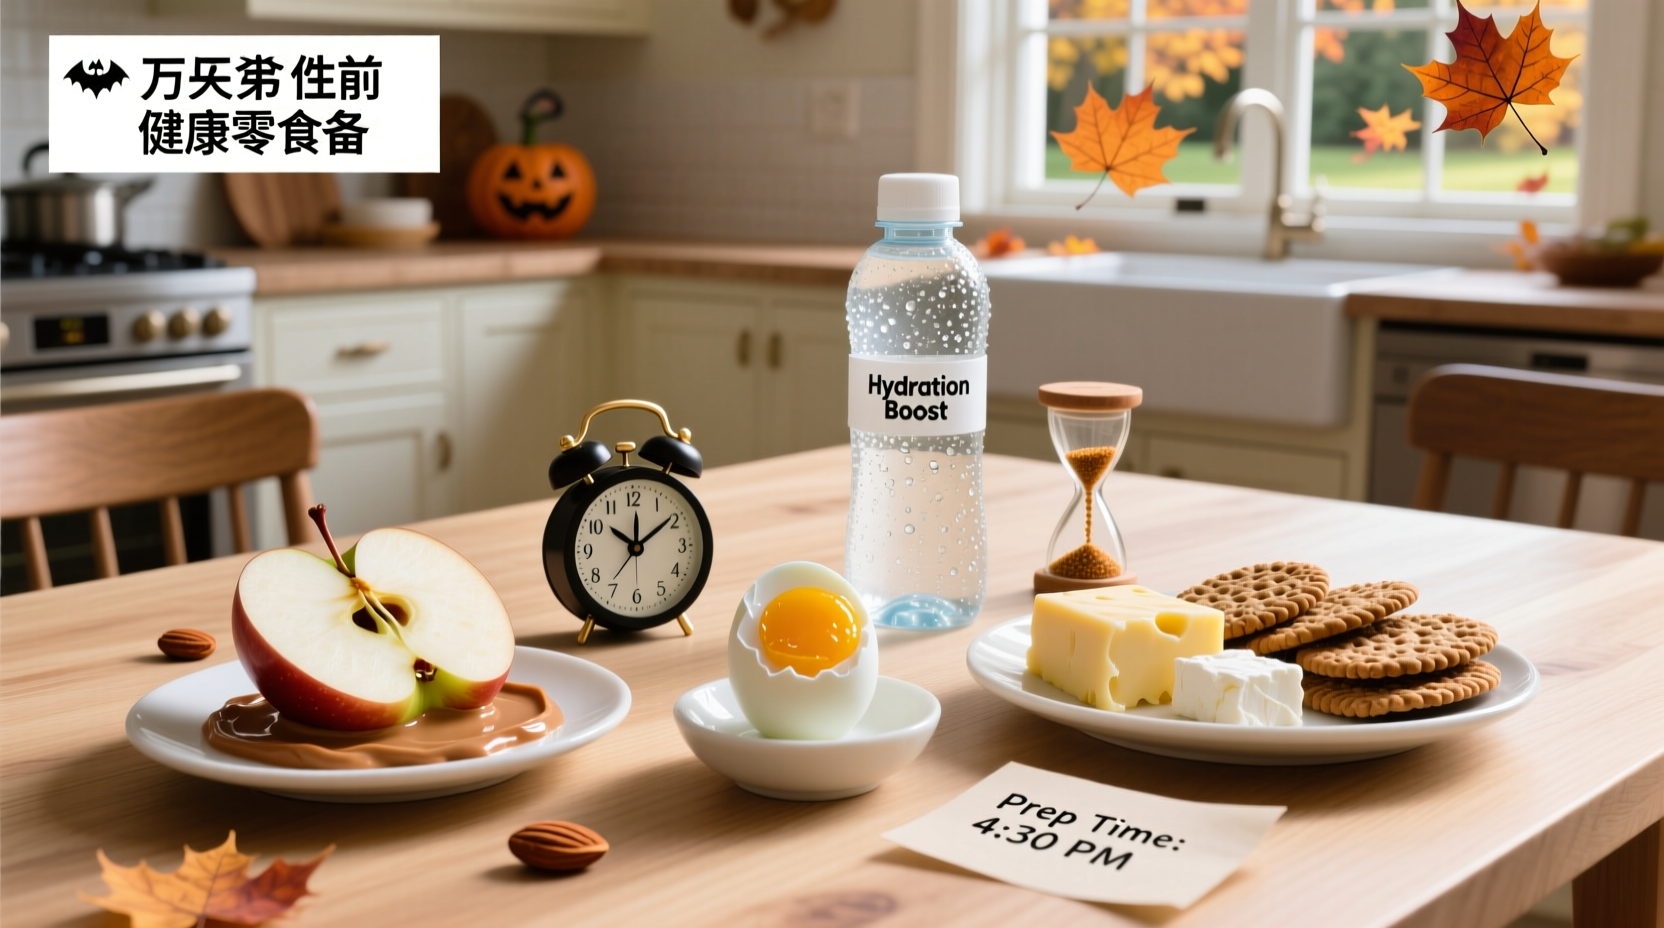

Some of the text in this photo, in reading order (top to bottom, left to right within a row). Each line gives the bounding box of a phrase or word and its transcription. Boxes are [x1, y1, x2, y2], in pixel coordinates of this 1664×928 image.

[868, 373, 970, 400] Hydration
[884, 400, 949, 421] Boost
[606, 500, 616, 515] 11
[626, 491, 641, 508] 12
[589, 519, 604, 535] 10
[669, 513, 680, 530] 2
[583, 543, 593, 560] 9
[677, 537, 687, 554] 3
[591, 567, 601, 584] 8
[670, 562, 680, 578] 4
[607, 583, 619, 599] 7
[632, 588, 642, 605] 6
[656, 580, 666, 597] 5
[996, 793, 1185, 851] Prep Time:
[972, 817, 1133, 871] 4:30 PM
